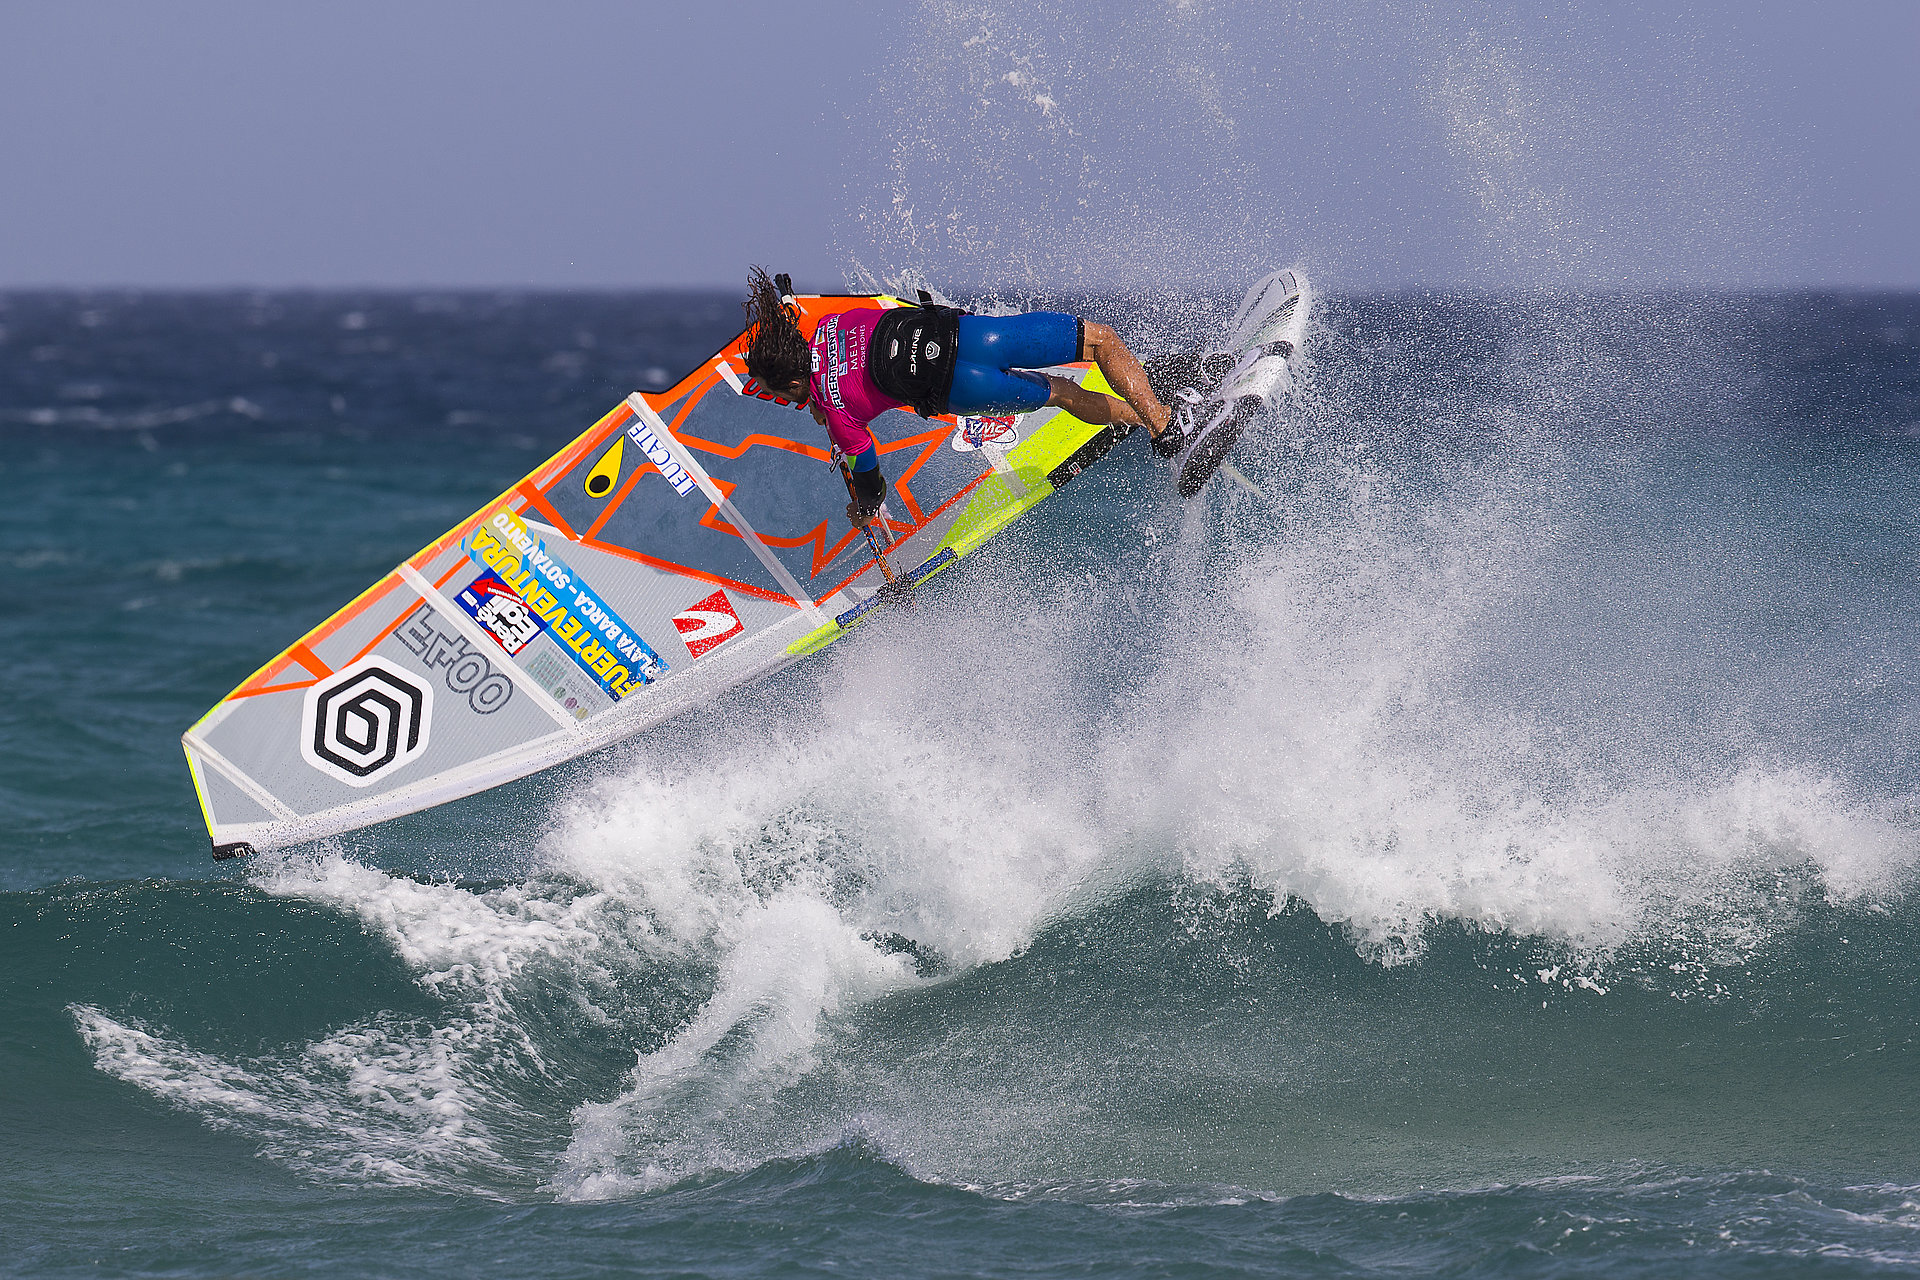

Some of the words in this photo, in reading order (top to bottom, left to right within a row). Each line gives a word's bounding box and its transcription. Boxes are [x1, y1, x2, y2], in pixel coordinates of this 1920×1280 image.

[629, 422, 696, 496] LEUCATE
[493, 512, 571, 590] SOTAVENTO
[470, 526, 642, 697] FUERTEVENTURA
[475, 603, 524, 655] René
[485, 595, 541, 644] Egli
[574, 590, 617, 641] BARCA
[616, 632, 661, 678] PLAYA
